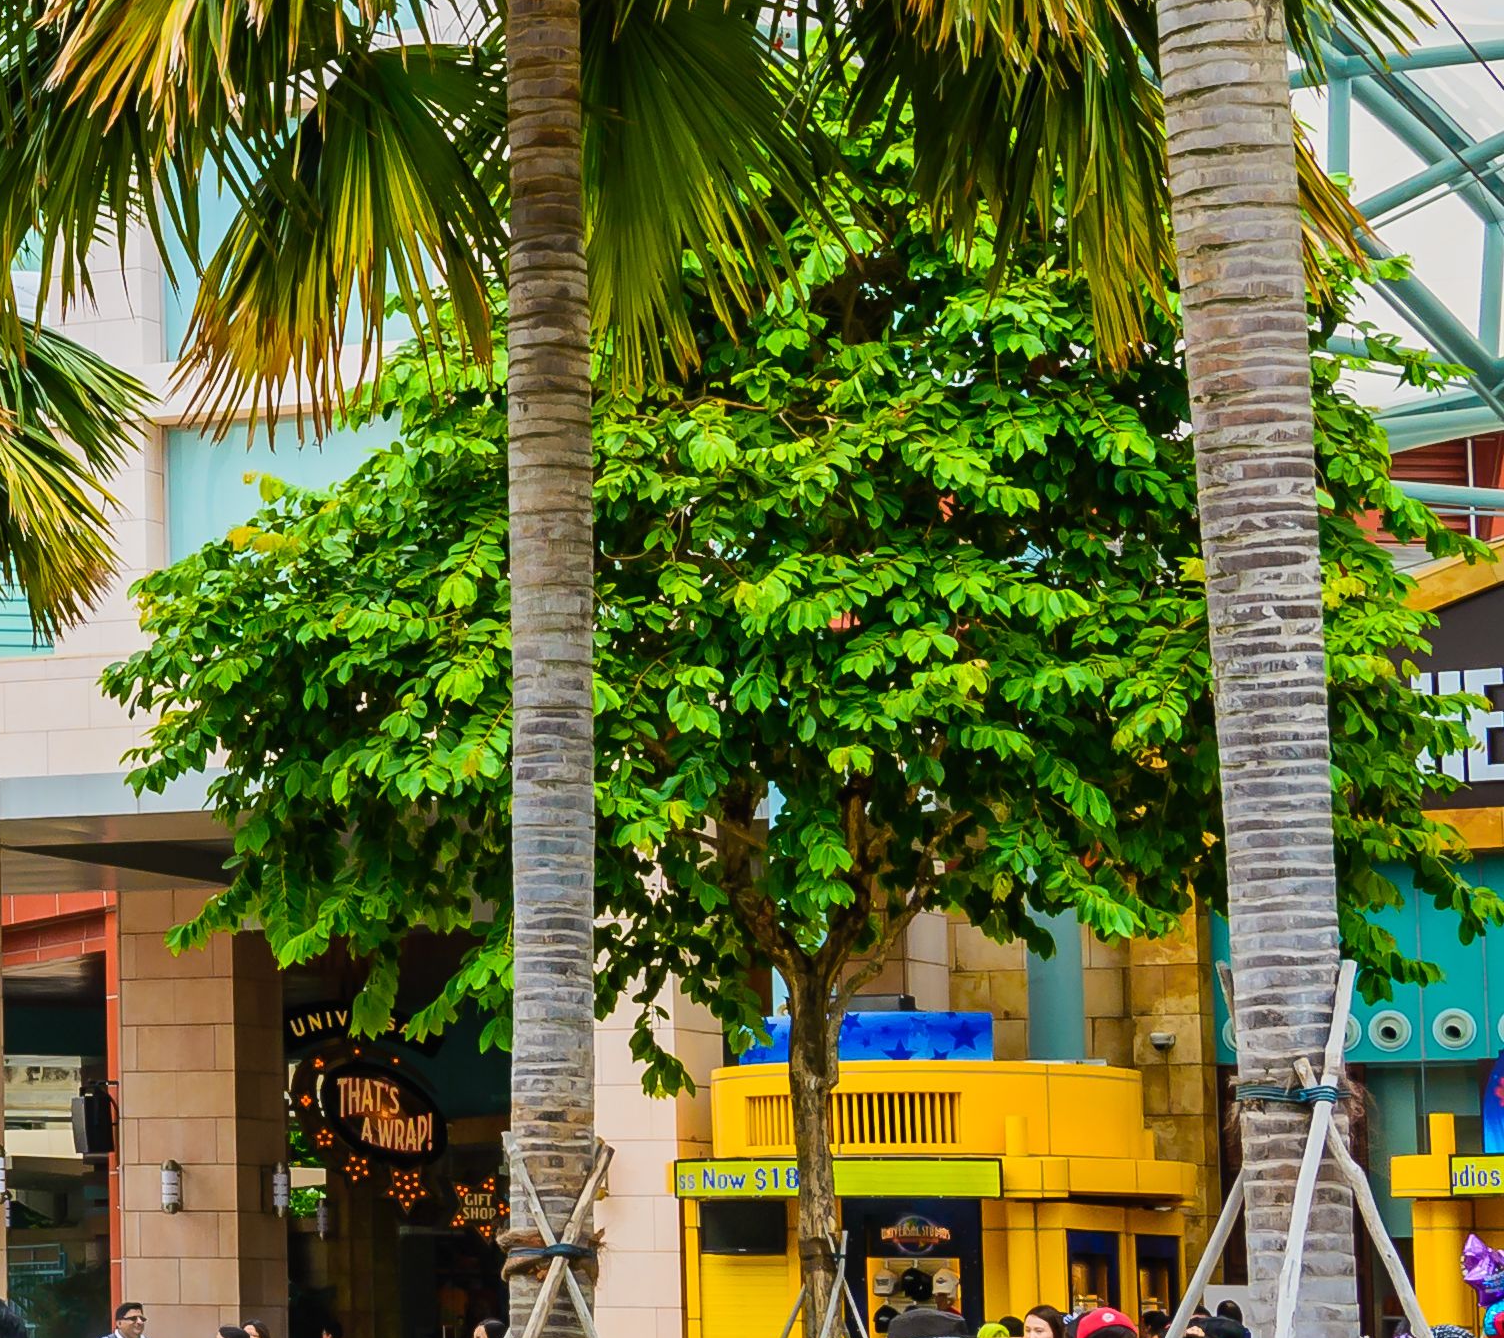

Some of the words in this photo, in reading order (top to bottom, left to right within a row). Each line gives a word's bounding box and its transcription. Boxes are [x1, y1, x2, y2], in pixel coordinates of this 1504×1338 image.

[290, 1010, 410, 1037] UNIVSA
[337, 1077, 400, 1117] THAT'S
[361, 1117, 373, 1144] A
[377, 1112, 433, 1152] WRAP!
[703, 1168, 746, 1190] Now
[464, 1193, 493, 1206] GIFT
[463, 1207, 497, 1220] SHOP
